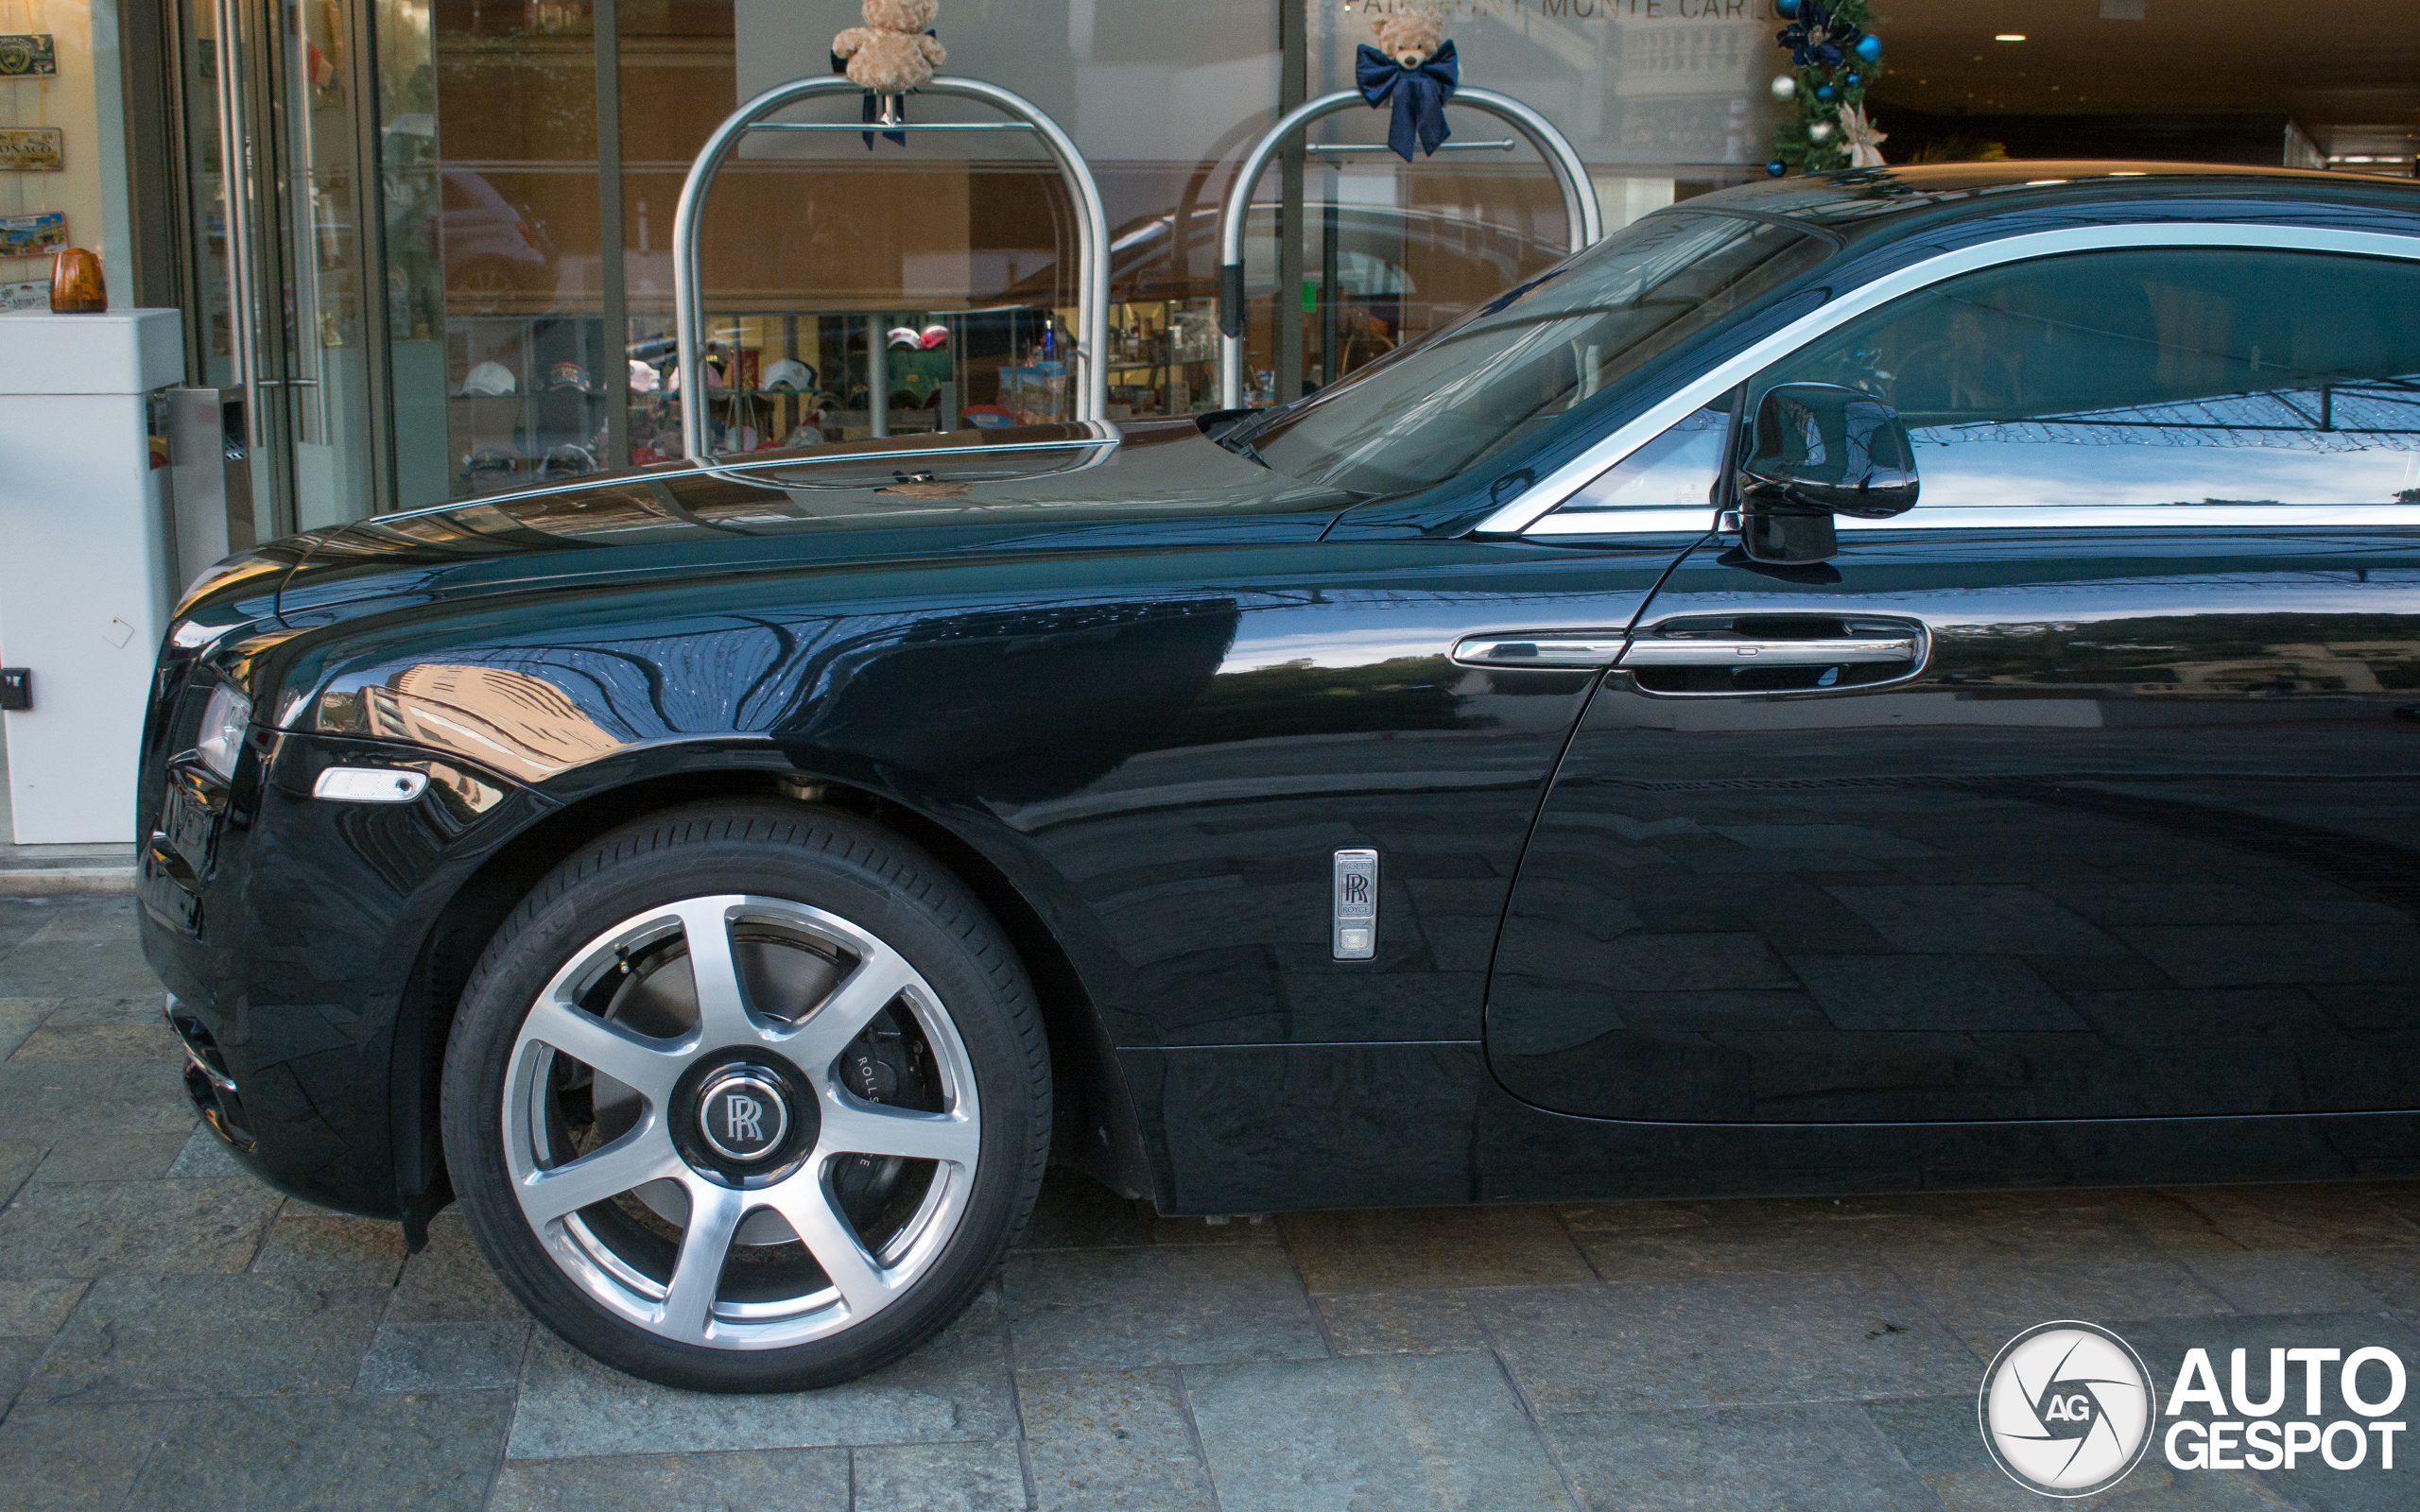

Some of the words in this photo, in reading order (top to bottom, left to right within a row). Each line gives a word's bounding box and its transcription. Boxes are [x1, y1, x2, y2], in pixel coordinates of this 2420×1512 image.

[1542, 0, 1663, 18] MONTE
[1345, 873, 1368, 903] RR
[857, 1057, 879, 1103] ROLLS
[726, 1094, 764, 1142] RR
